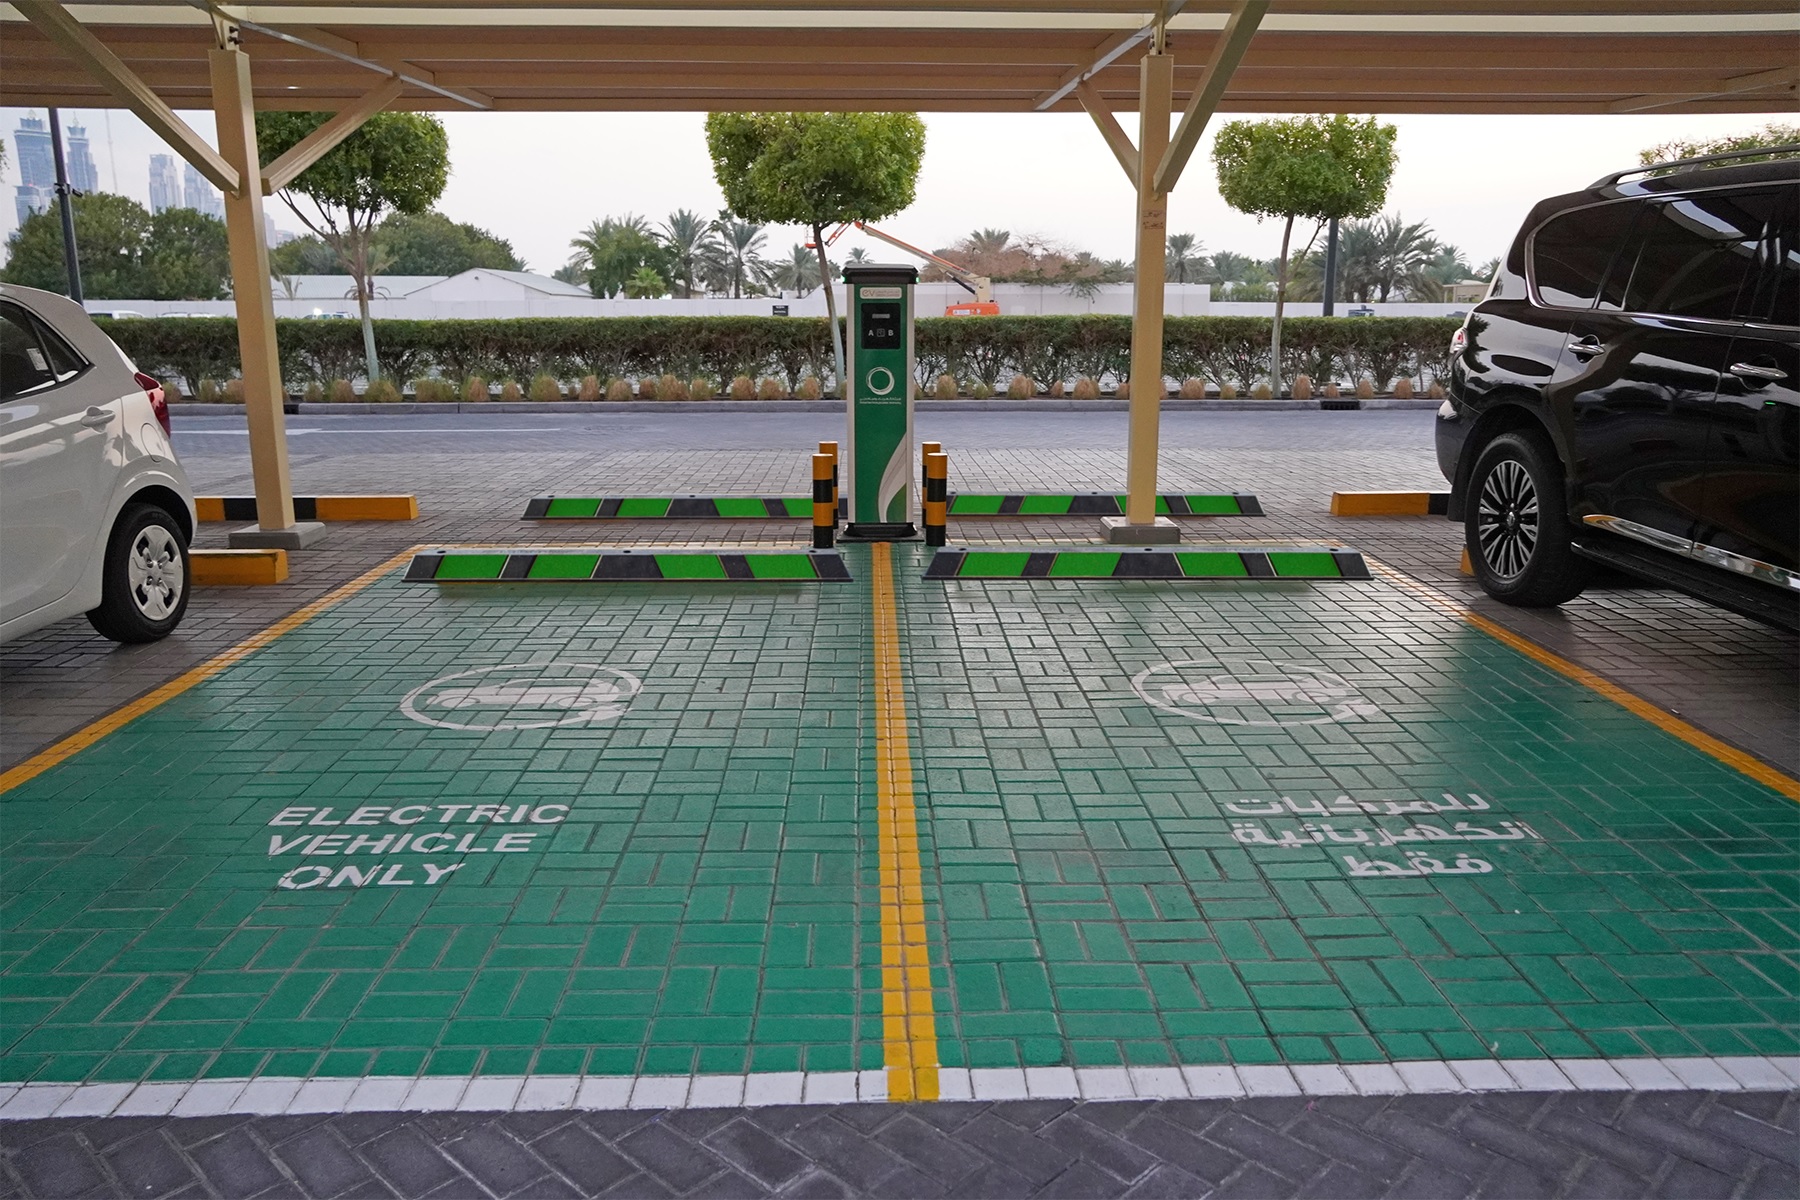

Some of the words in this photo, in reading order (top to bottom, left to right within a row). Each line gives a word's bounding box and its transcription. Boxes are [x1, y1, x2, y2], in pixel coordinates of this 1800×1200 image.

[267, 804, 570, 826] ELECTRIC
[1224, 793, 1490, 816] للمركبات
[268, 833, 537, 855] VEHICLE
[1342, 851, 1493, 876] فقط
[277, 862, 466, 890] ONLY
